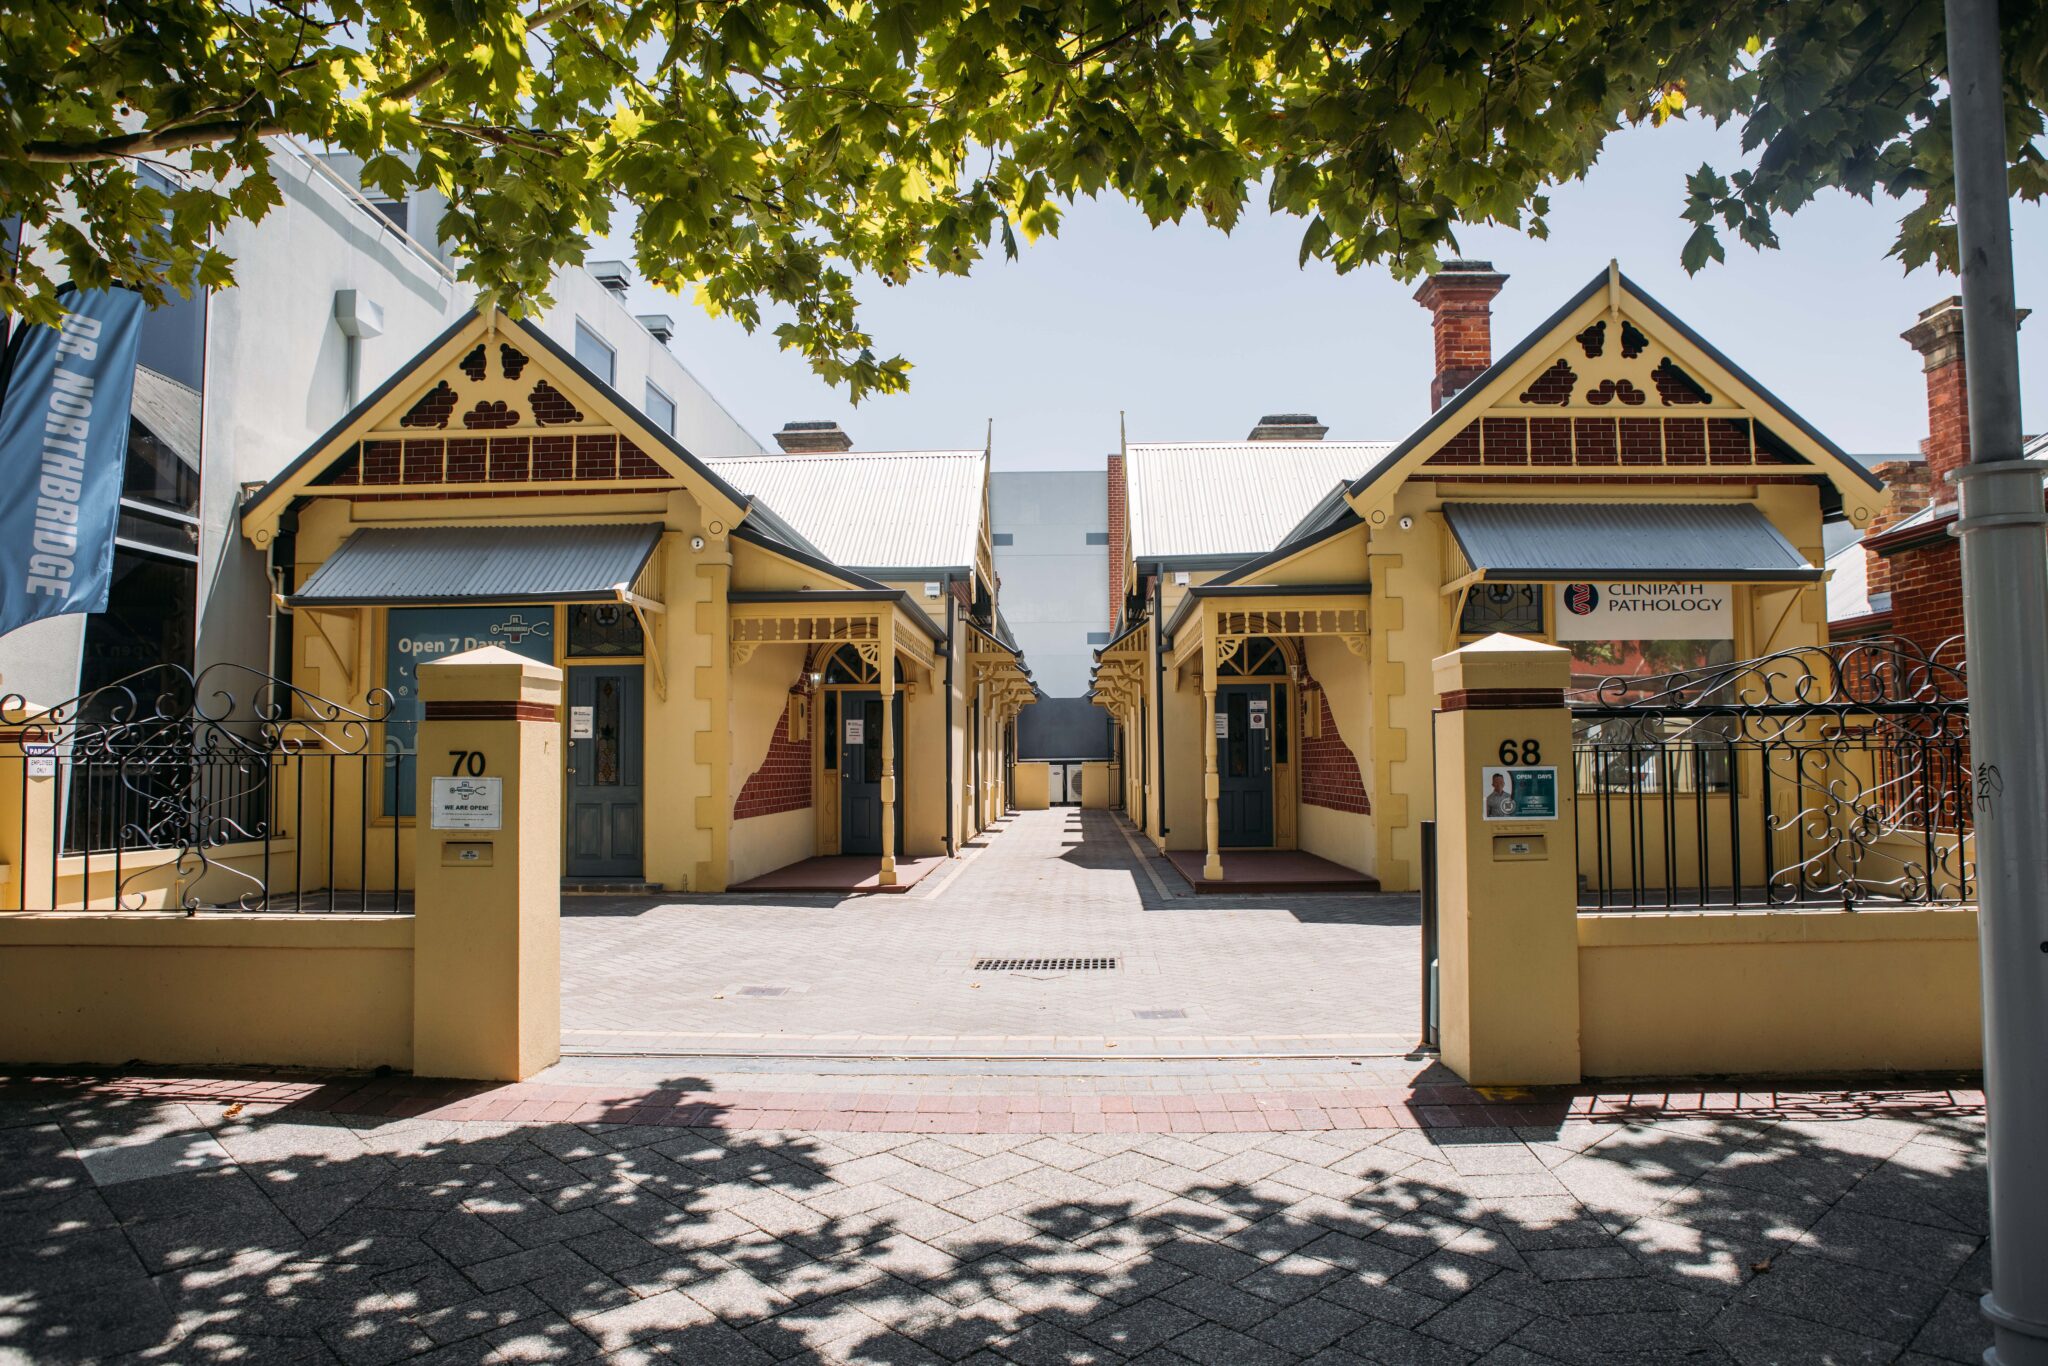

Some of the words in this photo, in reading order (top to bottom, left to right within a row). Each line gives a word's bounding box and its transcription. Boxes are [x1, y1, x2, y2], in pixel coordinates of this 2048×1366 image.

[55, 313, 103, 362] DR.
[26, 367, 94, 599] NORTHBRIDGE
[1608, 583, 1703, 596] CLINIPATH
[1609, 599, 1722, 612] PATHOLOGY
[398, 637, 445, 657] Open
[449, 638, 459, 652] 7
[449, 751, 486, 777] 70
[1499, 739, 1541, 766] 68
